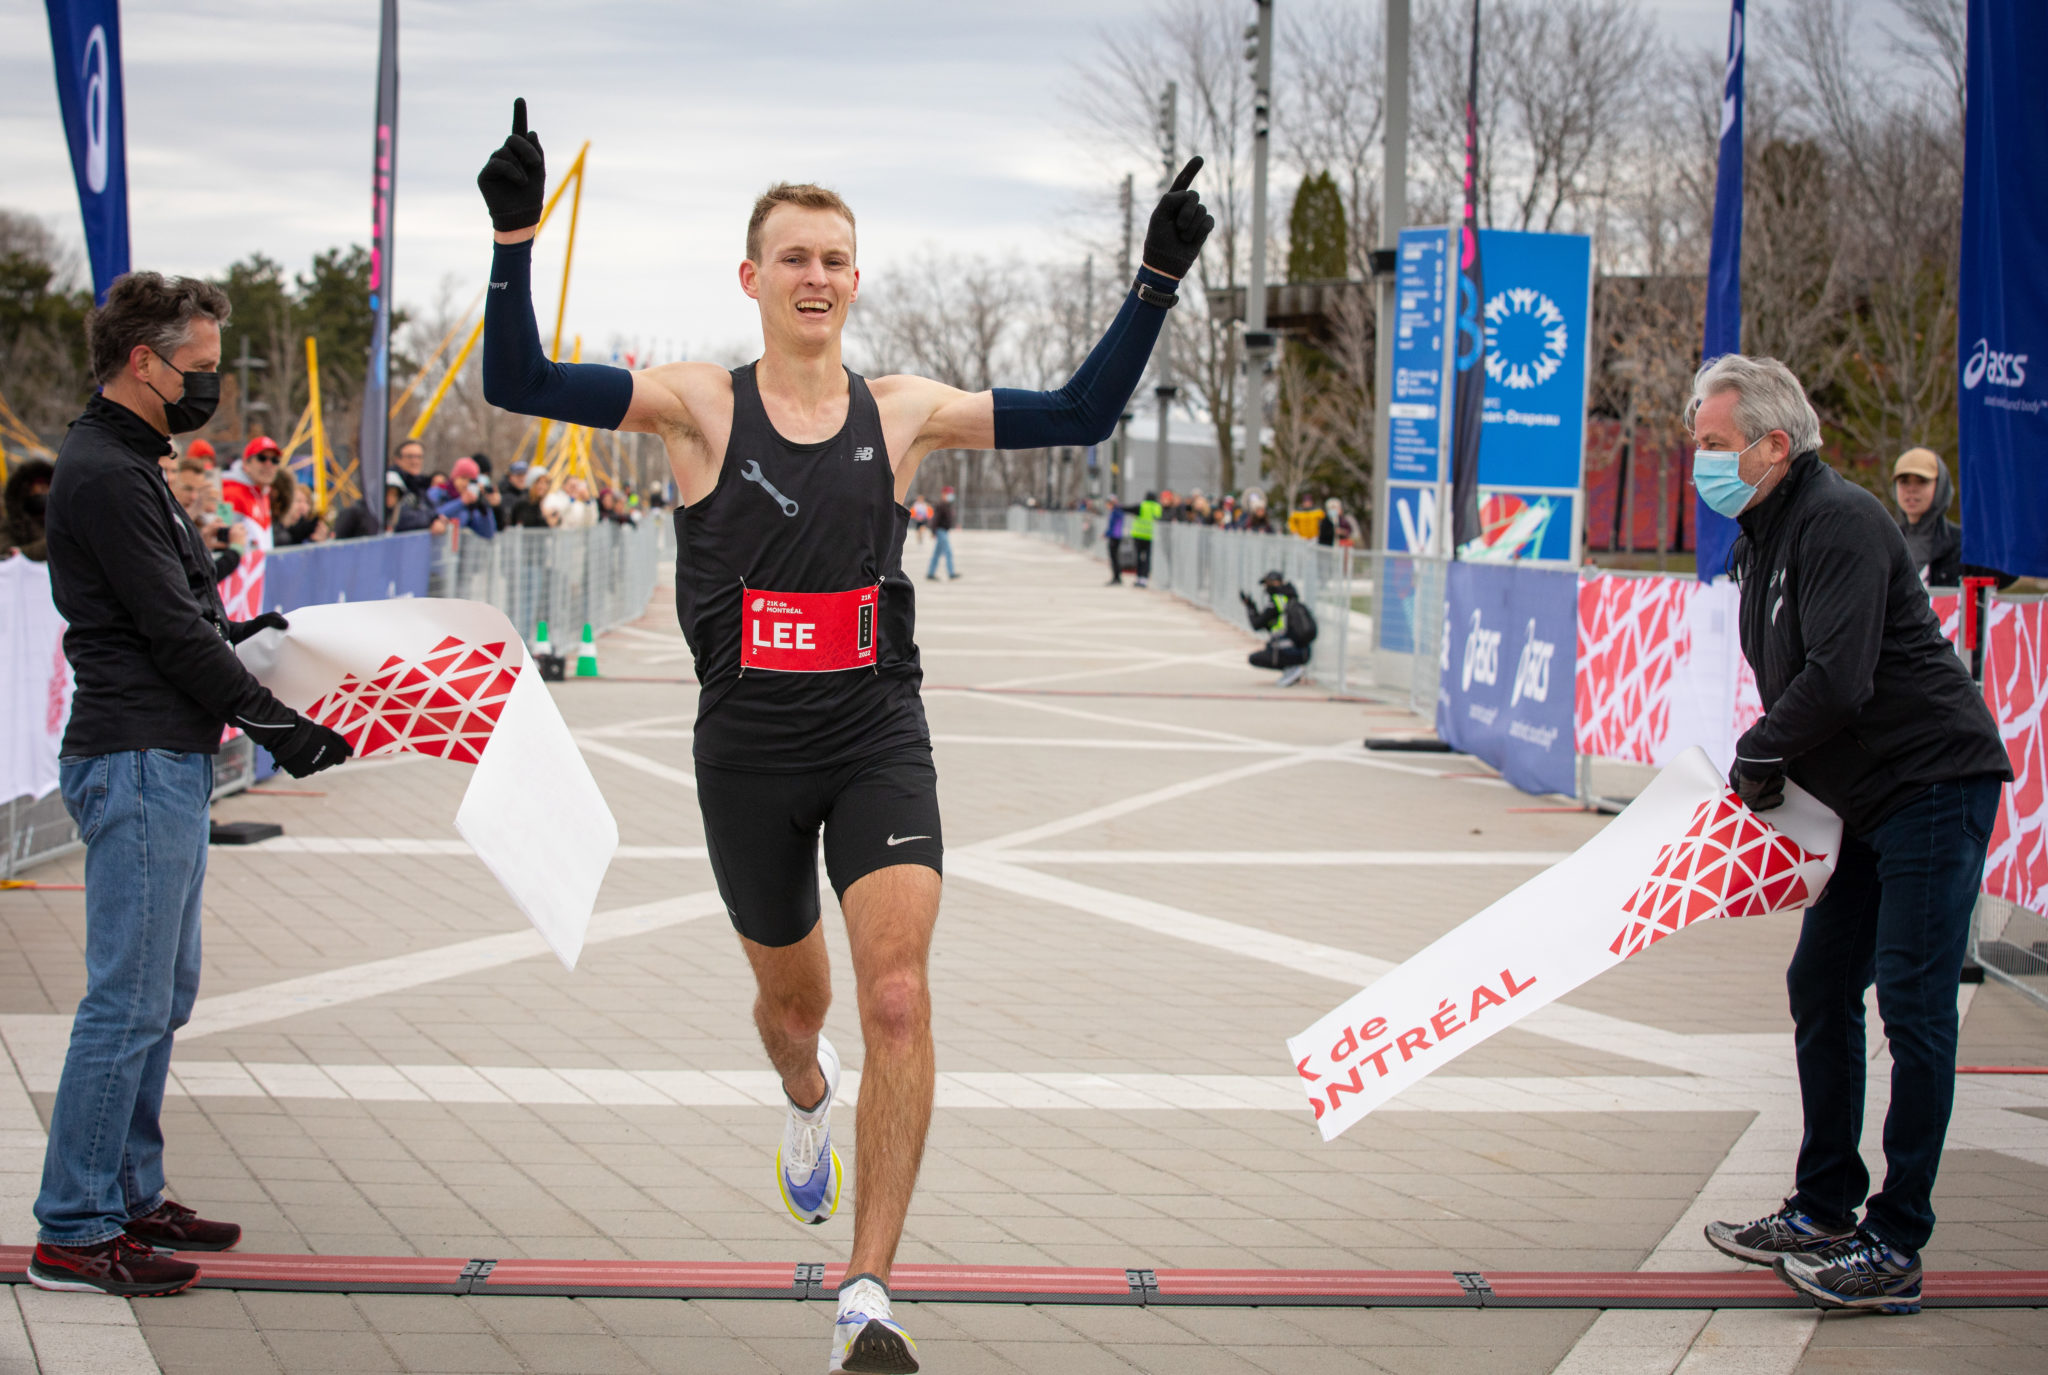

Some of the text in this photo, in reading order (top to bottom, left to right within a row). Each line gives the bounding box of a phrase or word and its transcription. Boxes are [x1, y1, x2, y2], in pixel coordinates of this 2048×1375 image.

[766, 606, 803, 615] MONTRÉAL
[753, 619, 816, 649] LEE
[752, 647, 758, 655] 2
[859, 650, 872, 659] 2022
[1330, 1016, 1389, 1063] de
